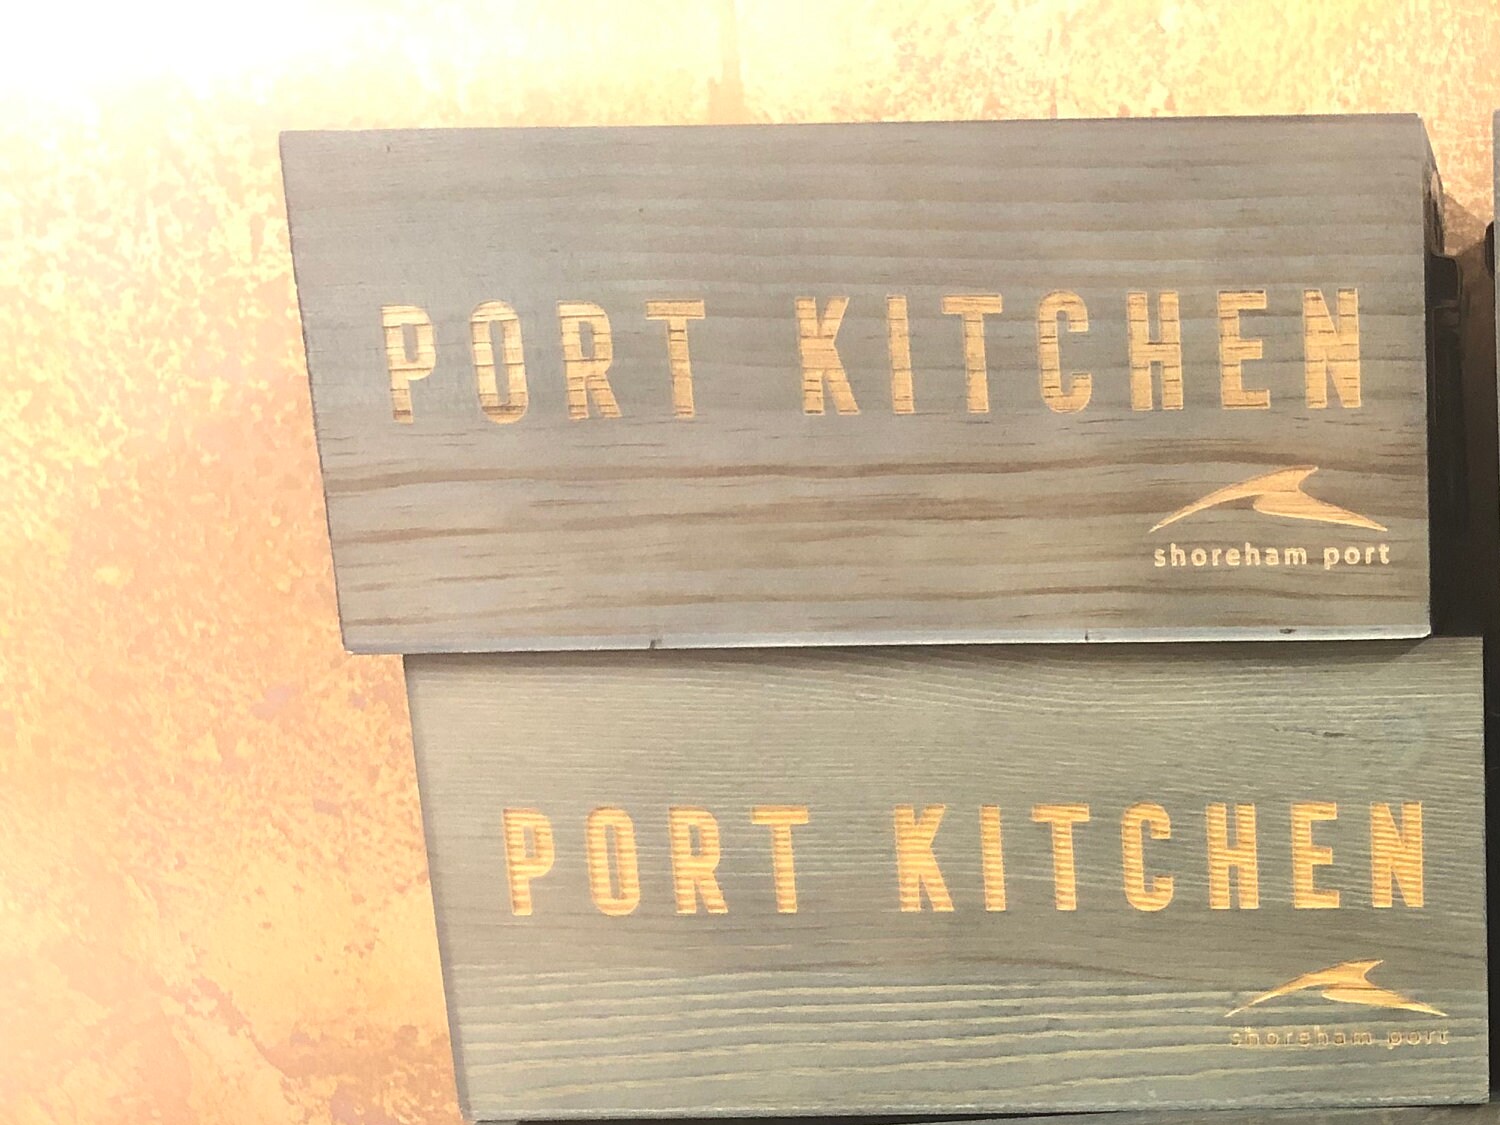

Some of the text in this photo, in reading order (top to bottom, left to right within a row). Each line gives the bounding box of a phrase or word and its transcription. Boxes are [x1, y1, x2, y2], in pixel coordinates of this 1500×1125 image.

[381, 287, 1362, 425] PORT KITCHEN
[1154, 543, 1390, 570] shoreham port
[502, 801, 1425, 916] PORT KITCHEN
[1230, 1026, 1373, 1046] shoreham
